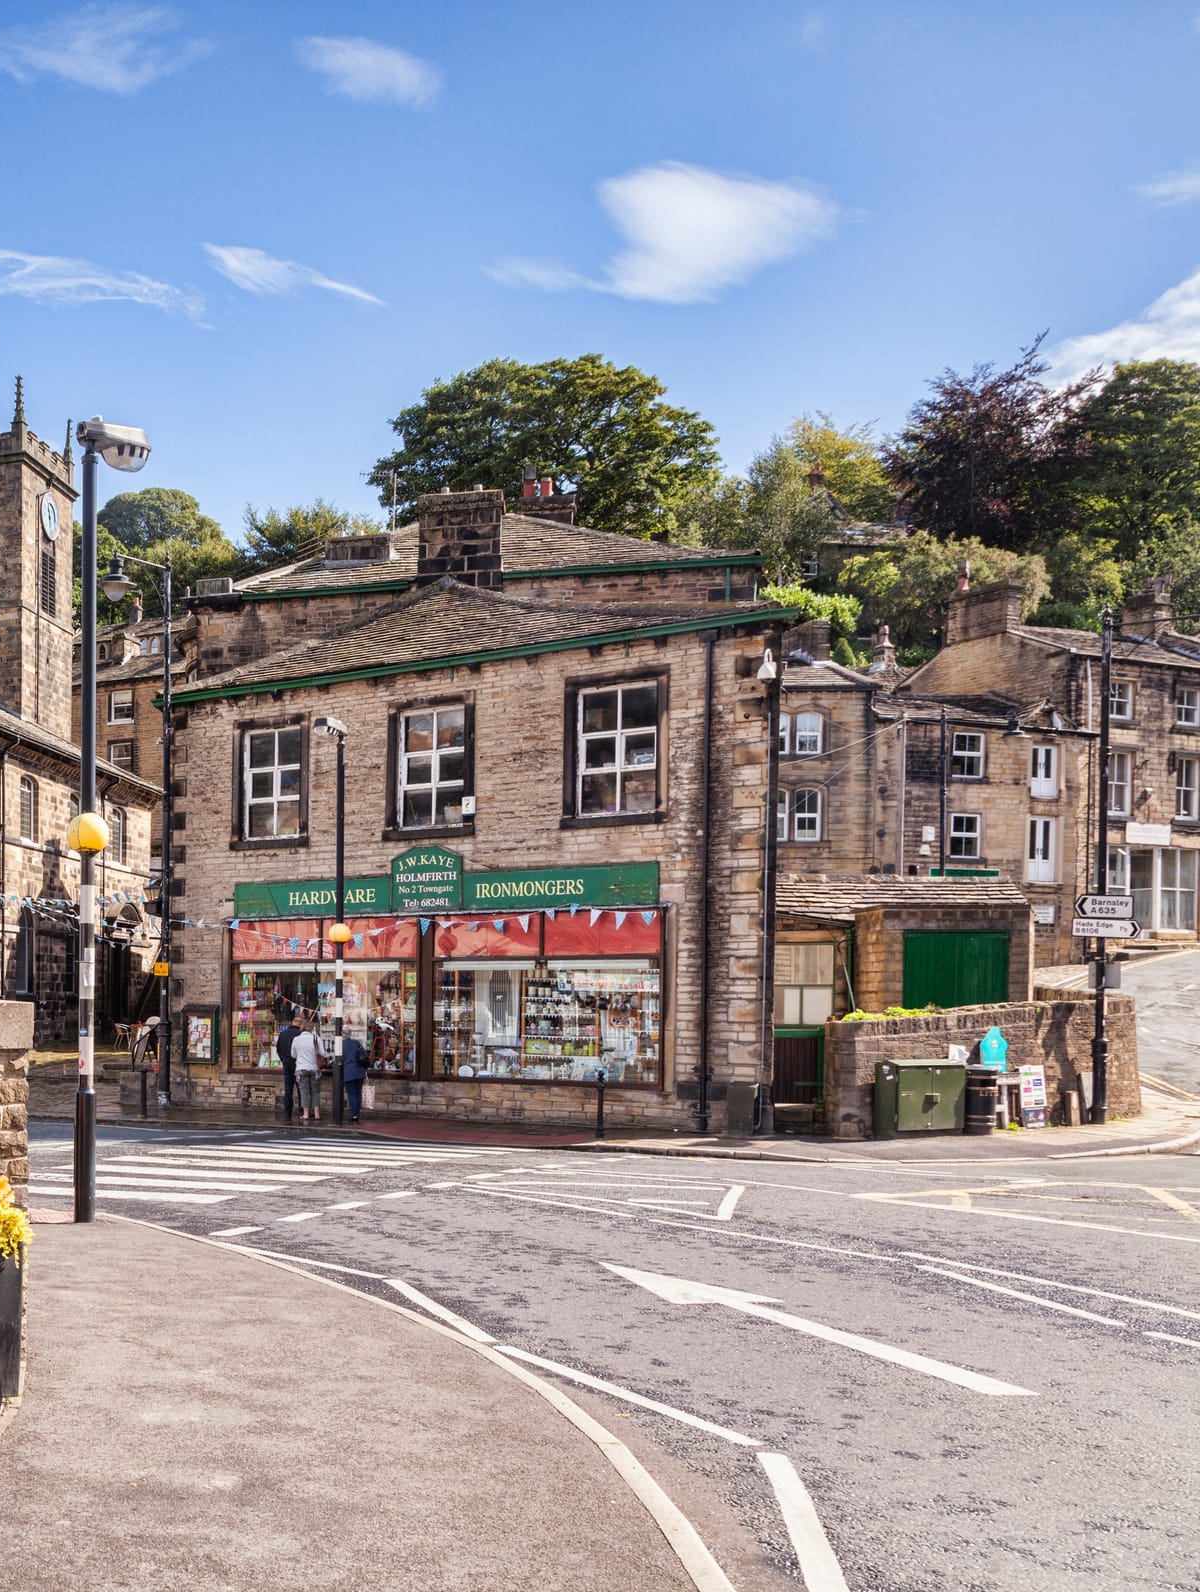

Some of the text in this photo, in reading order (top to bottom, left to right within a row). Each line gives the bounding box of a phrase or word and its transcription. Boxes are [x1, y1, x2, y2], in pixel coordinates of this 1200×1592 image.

[395, 871, 457, 883] HOLMFIRTH
[398, 885, 454, 895] No 2 Towngate
[475, 879, 584, 899] IRONMONGERS
[421, 898, 449, 907] 682481
[1091, 898, 1129, 907] Barnsley
